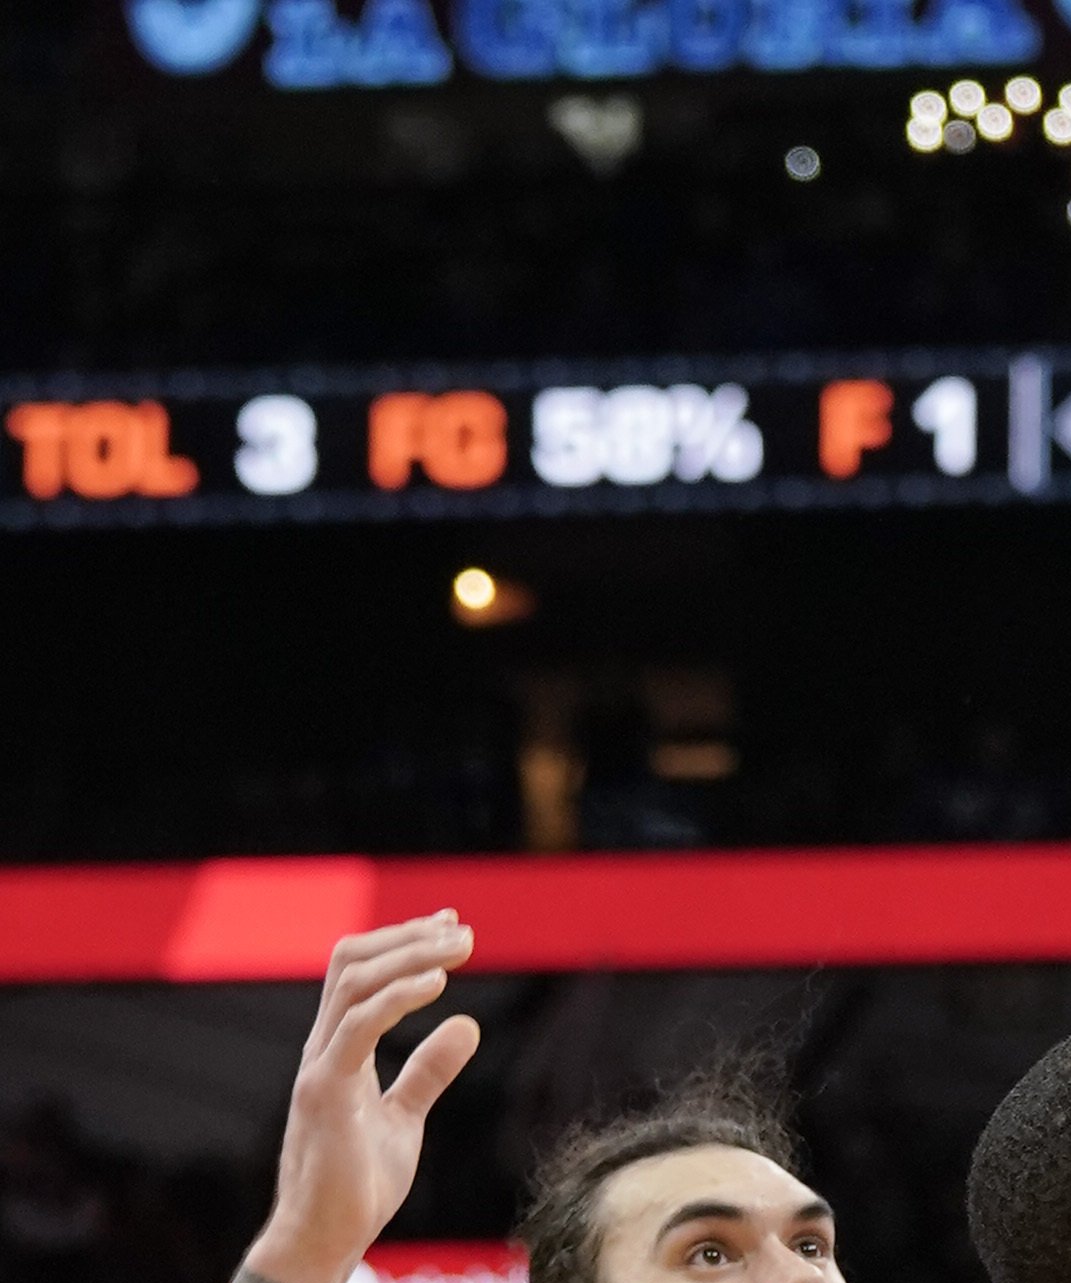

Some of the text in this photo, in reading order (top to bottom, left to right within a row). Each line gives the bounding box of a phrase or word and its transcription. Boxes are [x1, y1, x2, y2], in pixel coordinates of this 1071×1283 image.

[6, 400, 200, 498] TOL
[234, 394, 318, 495] 3
[367, 390, 508, 490] FG
[818, 378, 894, 478] F
[911, 376, 978, 477] 1
